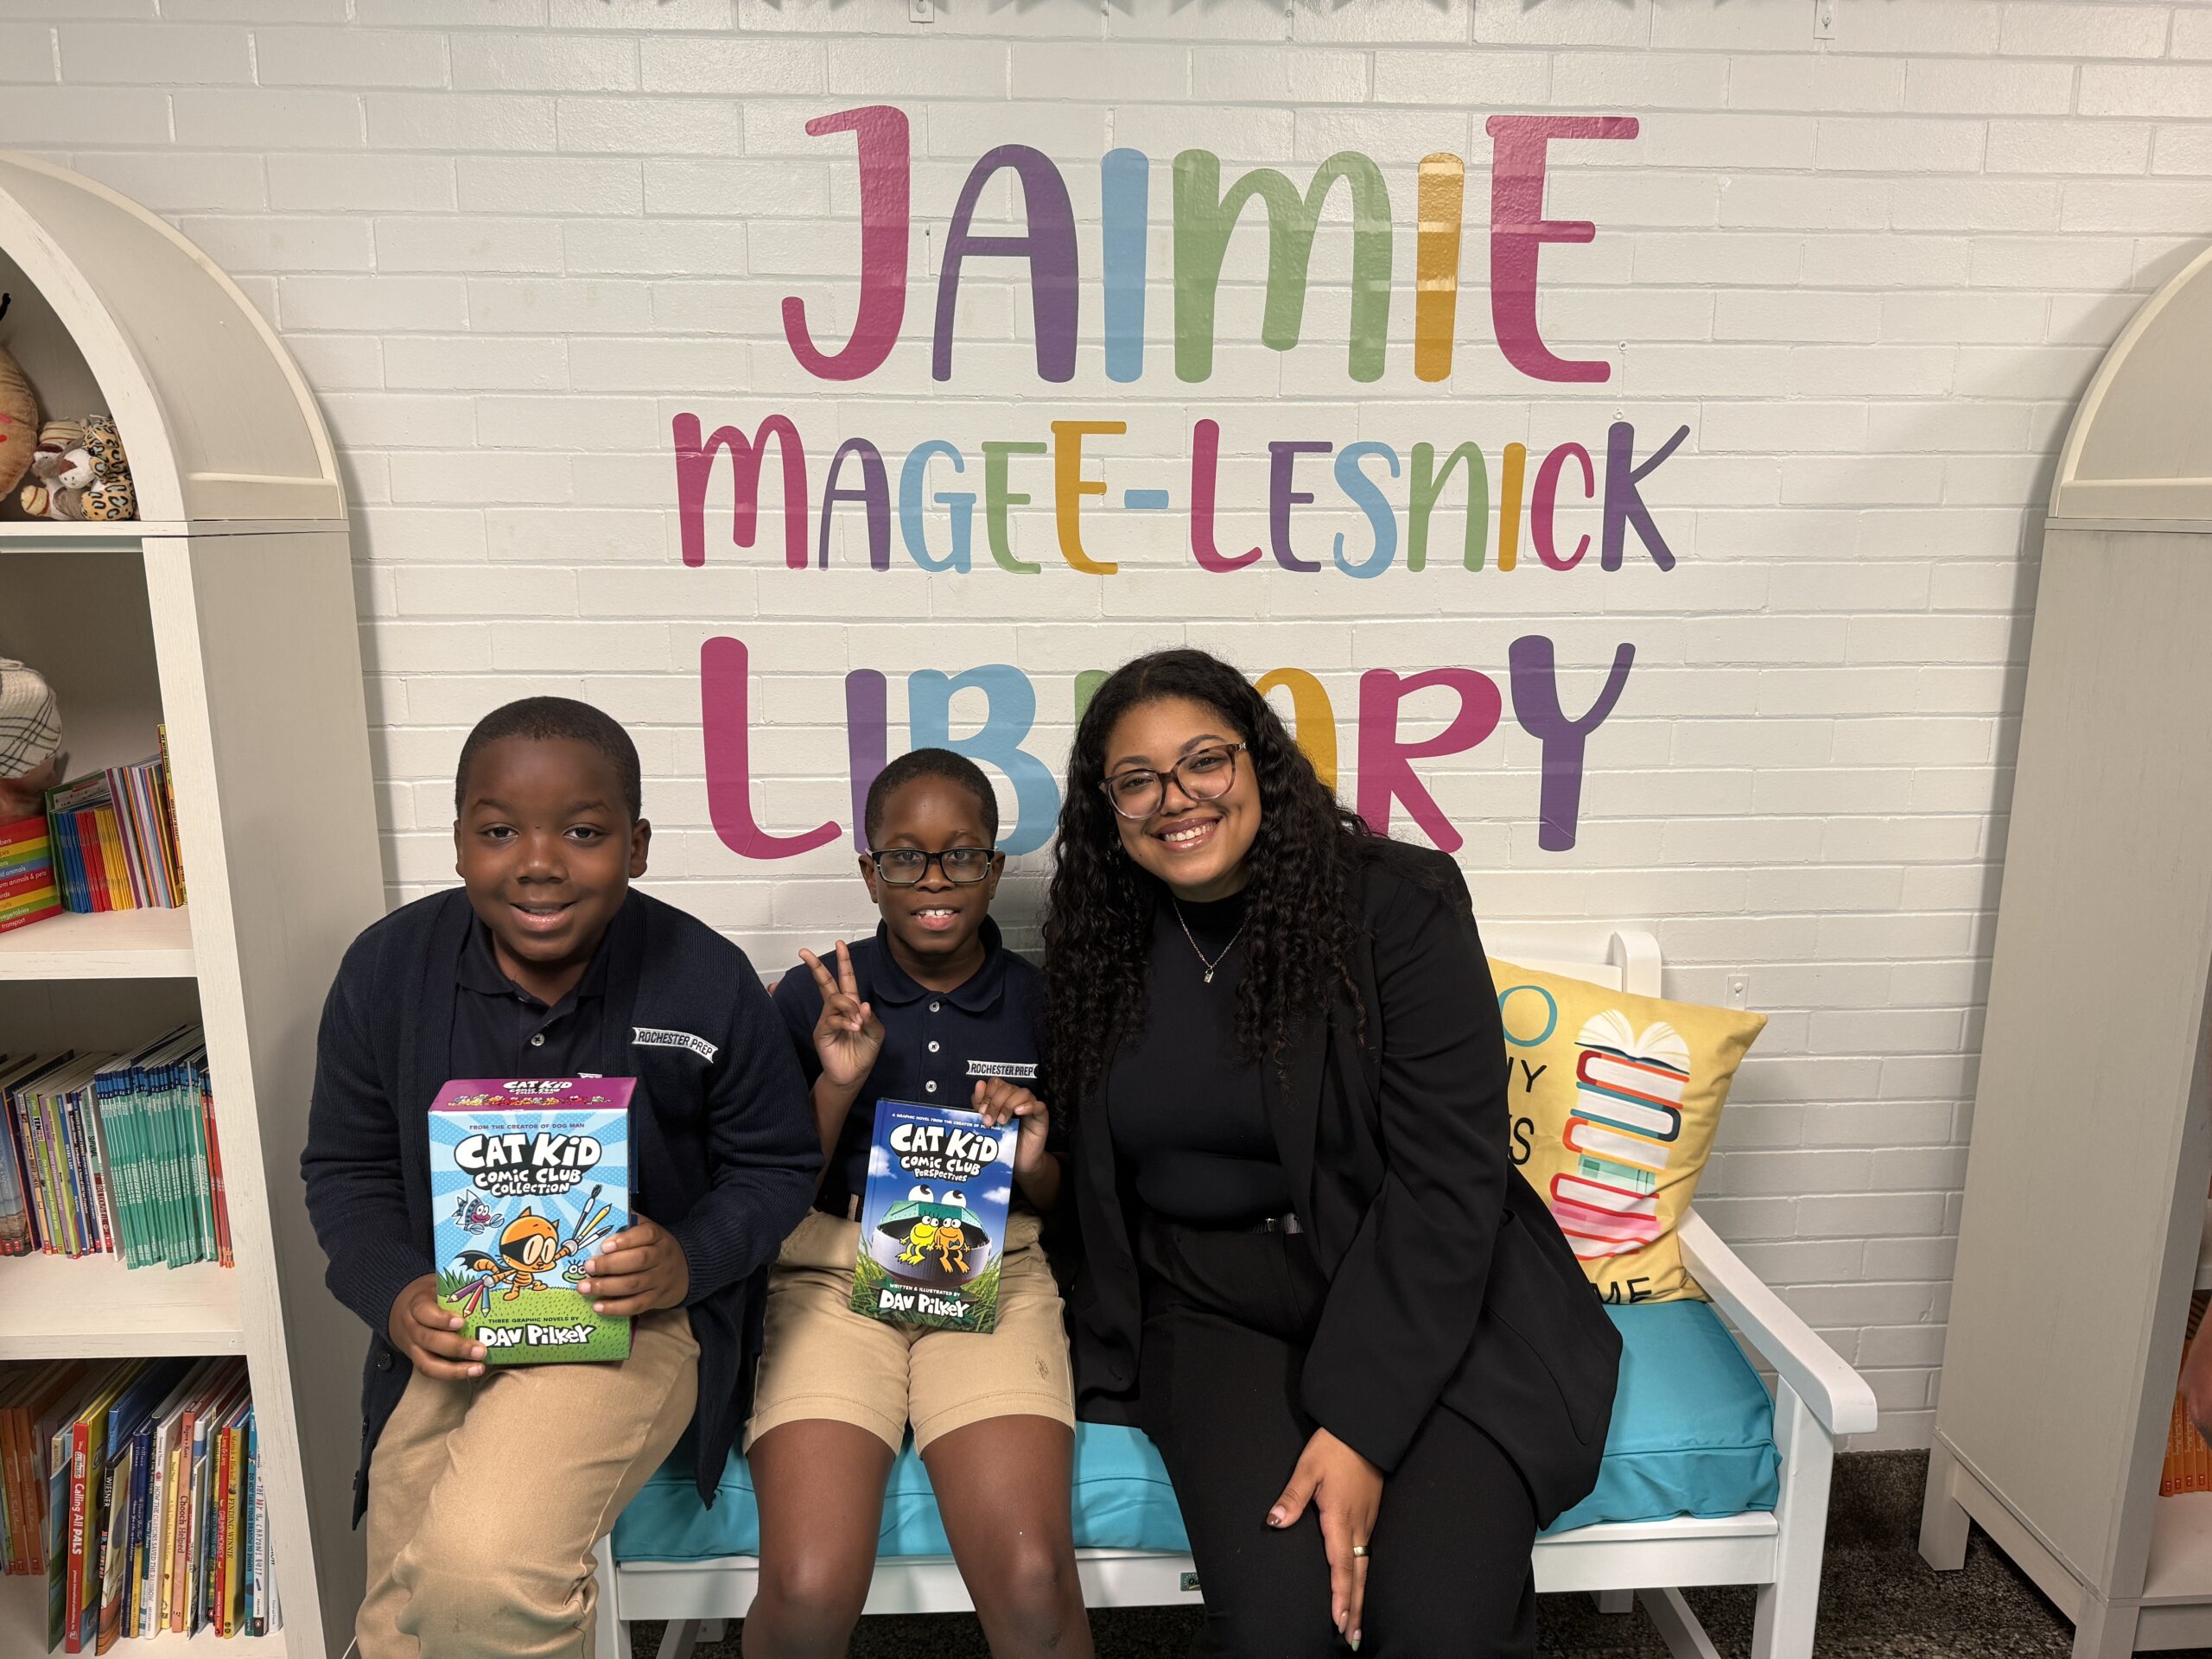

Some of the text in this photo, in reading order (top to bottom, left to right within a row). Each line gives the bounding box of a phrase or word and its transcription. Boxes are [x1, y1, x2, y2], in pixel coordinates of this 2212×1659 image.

[783, 106, 1639, 382] JAIMIE
[673, 413, 1690, 578] MAGEE-LESNICK
[701, 636, 1635, 860] LIBRY
[5, 865, 26, 876] animals
[10, 874, 29, 886] animals
[35, 870, 48, 880] pets
[2, 917, 26, 930] transport
[638, 1031, 713, 1055] ROCHESTER PREP
[971, 1063, 1033, 1076] ROCHESTER PREP
[890, 1123, 944, 1152] CAT
[454, 1134, 526, 1169] CAT
[536, 1168, 582, 1183] CLUB
[946, 1159, 981, 1176] CLUB
[879, 1289, 915, 1311] DAV
[1590, 1276, 1653, 1305] ME
[479, 1327, 523, 1347] DAV
[72, 1484, 85, 1511] Calling
[103, 1476, 113, 1507] WIESNER
[73, 1514, 84, 1527] All
[179, 1495, 188, 1525] Chooch
[72, 1529, 83, 1555] PALS
[177, 1528, 186, 1554] Helped
